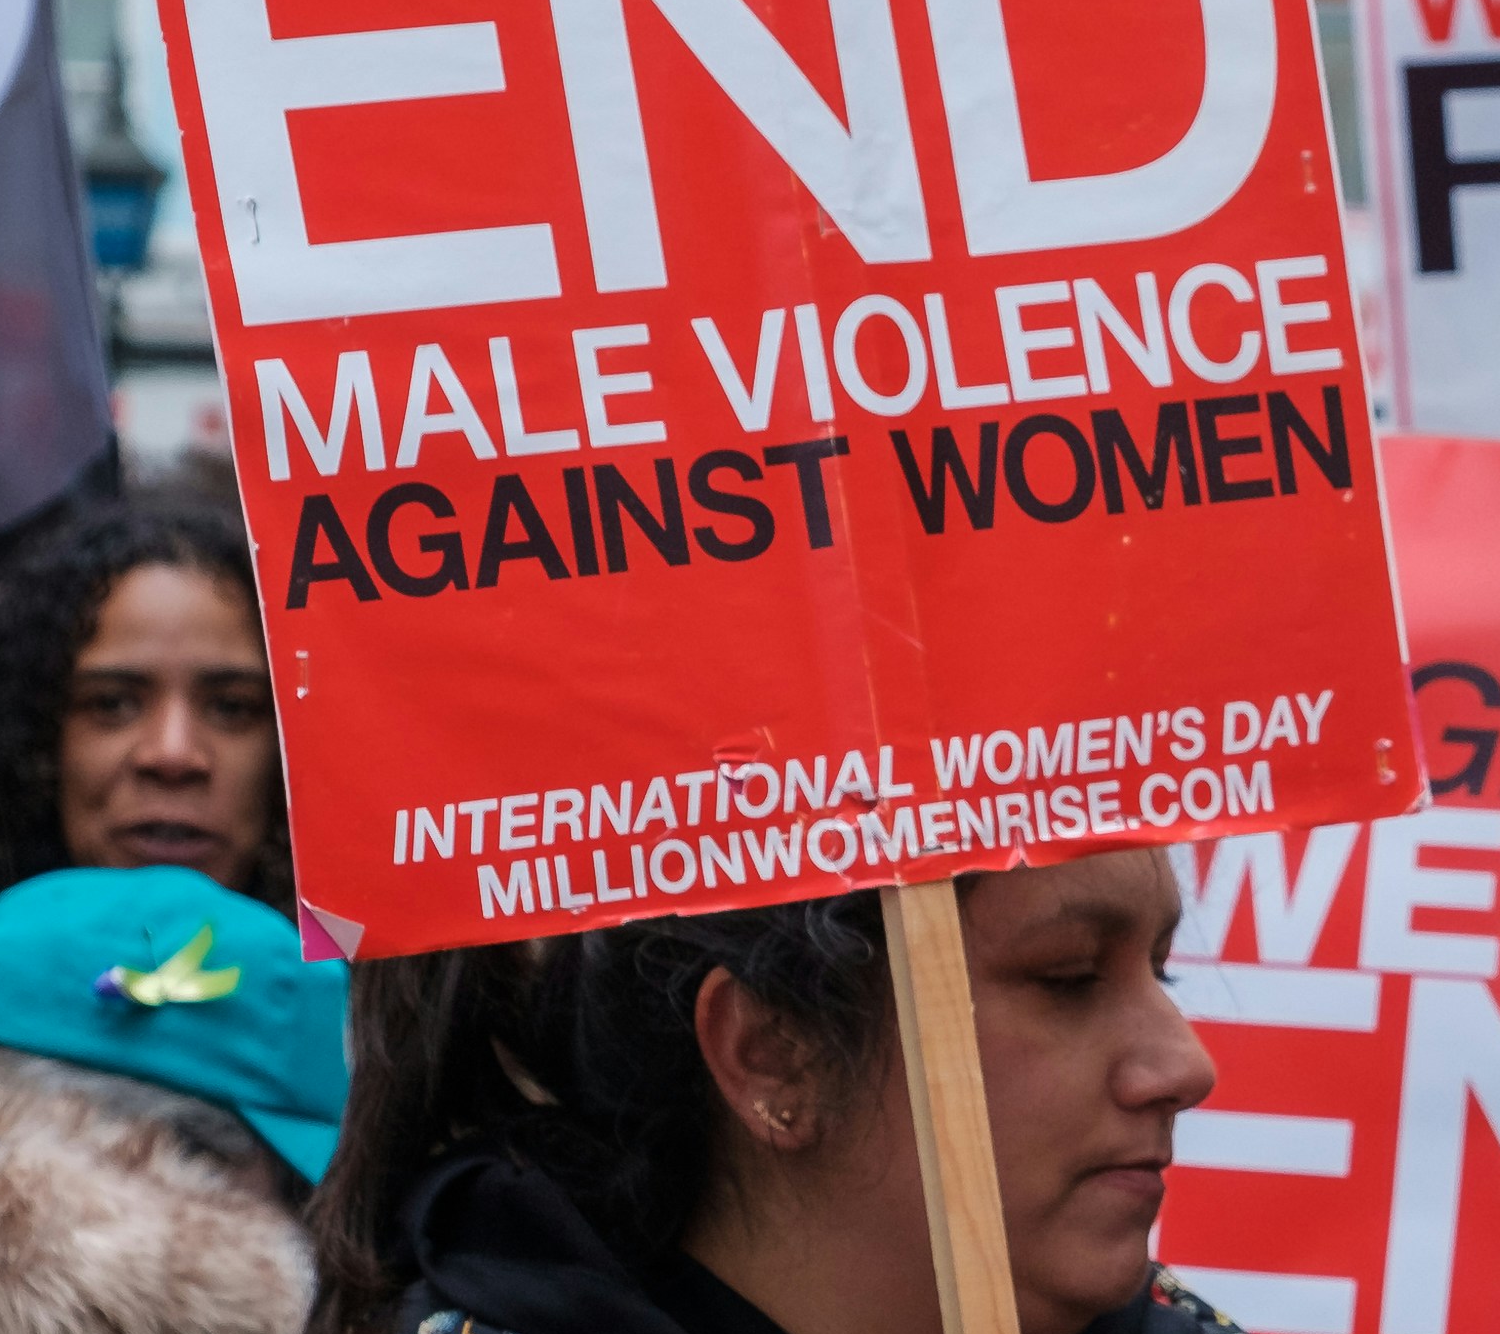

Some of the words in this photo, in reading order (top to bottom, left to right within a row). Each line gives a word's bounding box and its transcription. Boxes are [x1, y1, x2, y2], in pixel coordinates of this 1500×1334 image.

[252, 322, 668, 483] MALE
[690, 254, 1345, 433] VIOLENCE
[285, 436, 850, 610] AGAINST
[890, 384, 1354, 536] WOMEN
[392, 740, 909, 866] INTERNATIONAL
[928, 707, 1208, 795] WOMEN'S
[1220, 689, 1335, 759] DAY
[475, 759, 1276, 921] MILLIONWOMENRISE.COM
